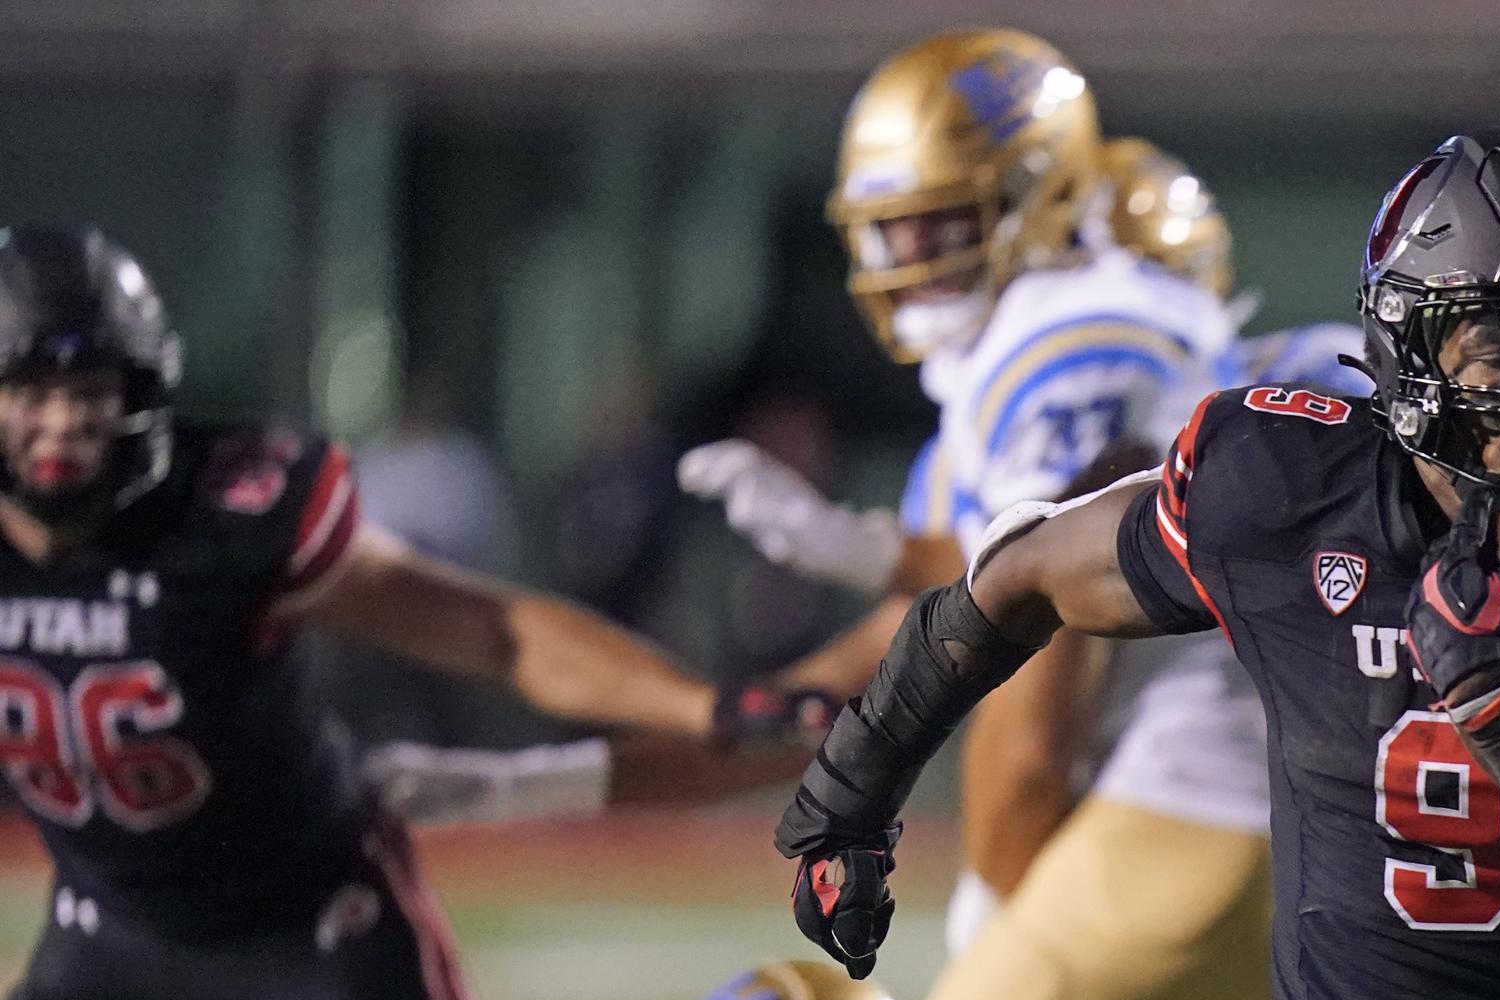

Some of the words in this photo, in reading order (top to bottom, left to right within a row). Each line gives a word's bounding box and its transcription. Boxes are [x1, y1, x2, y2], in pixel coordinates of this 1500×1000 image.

[1243, 386, 1352, 425] 9
[1318, 555, 1364, 593] PAC
[1326, 579, 1351, 601] 12
[0, 657, 213, 833] 96
